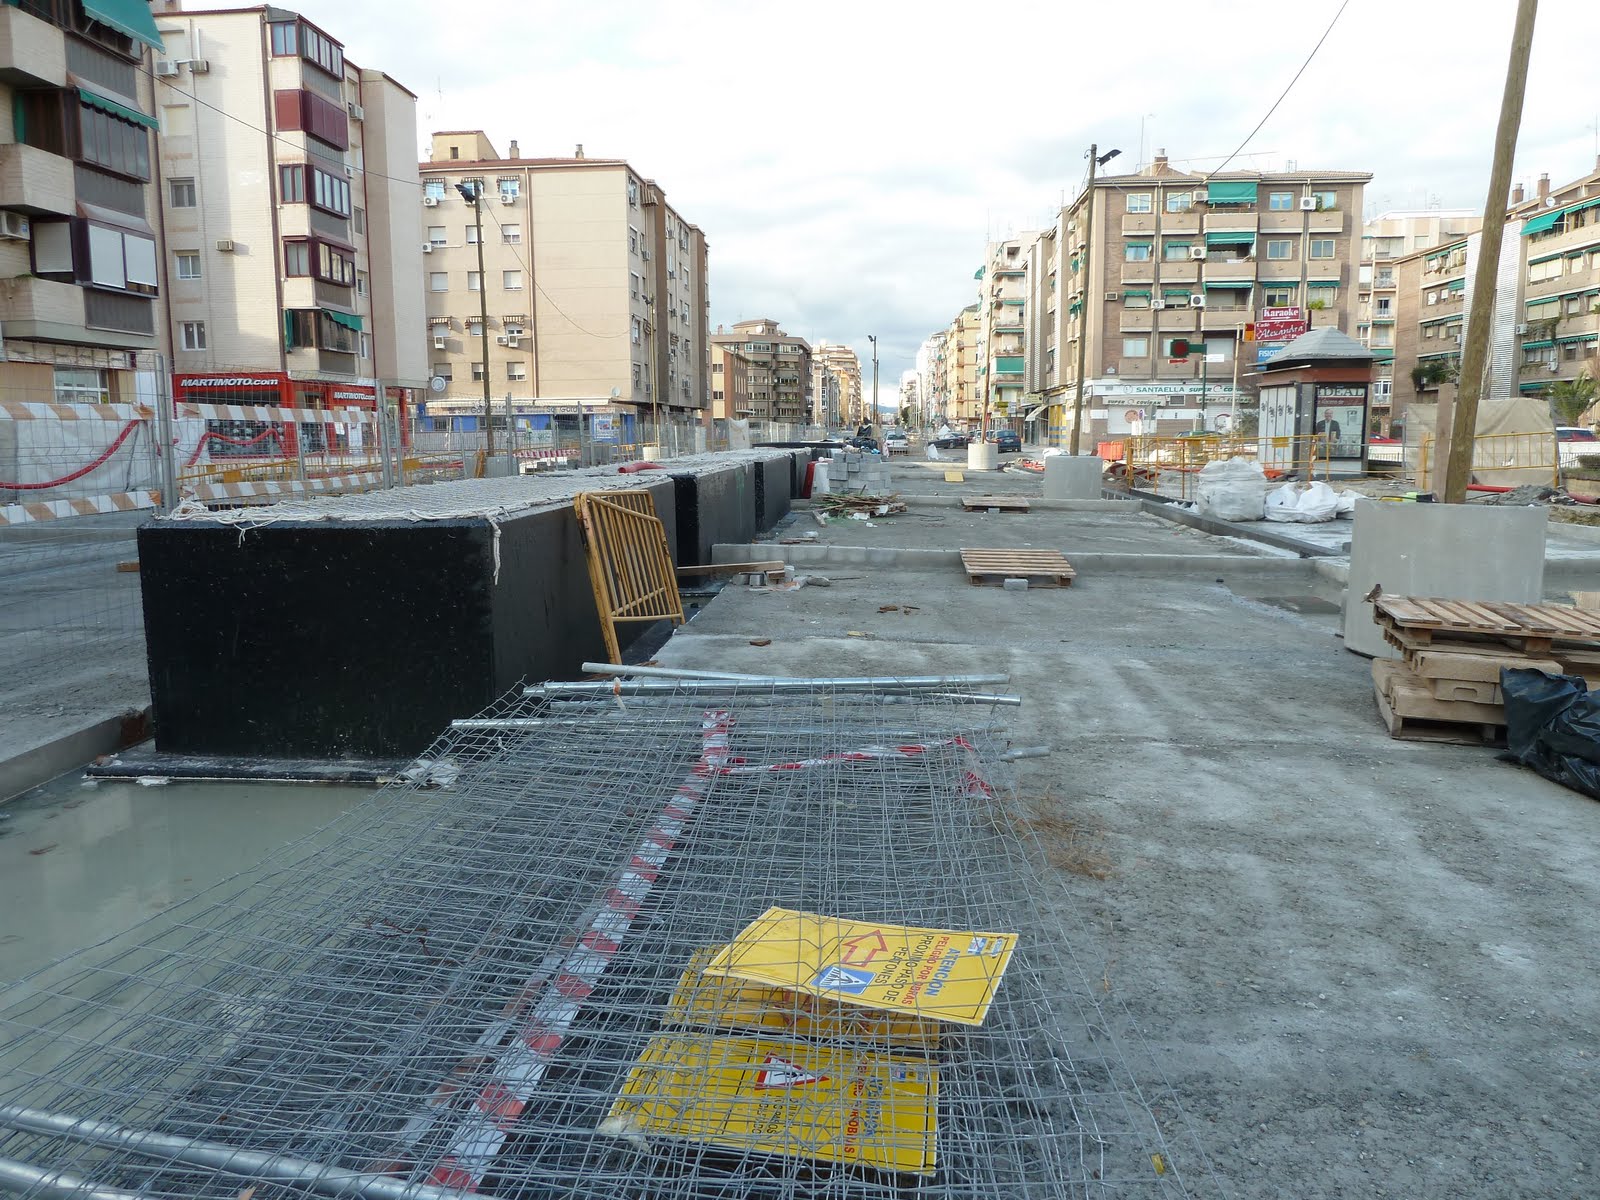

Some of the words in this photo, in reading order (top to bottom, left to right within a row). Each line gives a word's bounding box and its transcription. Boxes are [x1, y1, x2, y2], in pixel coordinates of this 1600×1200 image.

[1263, 308, 1299, 317] Karaoke
[1256, 324, 1304, 340] Alexandra
[180, 378, 279, 387] MARTIMOTO.com
[334, 391, 376, 401] MARTIMOTO.com
[905, 934, 935, 968] PRÓXIMO
[928, 936, 950, 965] PELIGRO
[875, 946, 909, 984] PEATONES
[917, 965, 933, 981] POR
[924, 948, 961, 996] ATENCIÓN
[891, 968, 913, 990] PASO
[882, 990, 900, 1002] DE
[901, 981, 924, 1005] OBRAS
